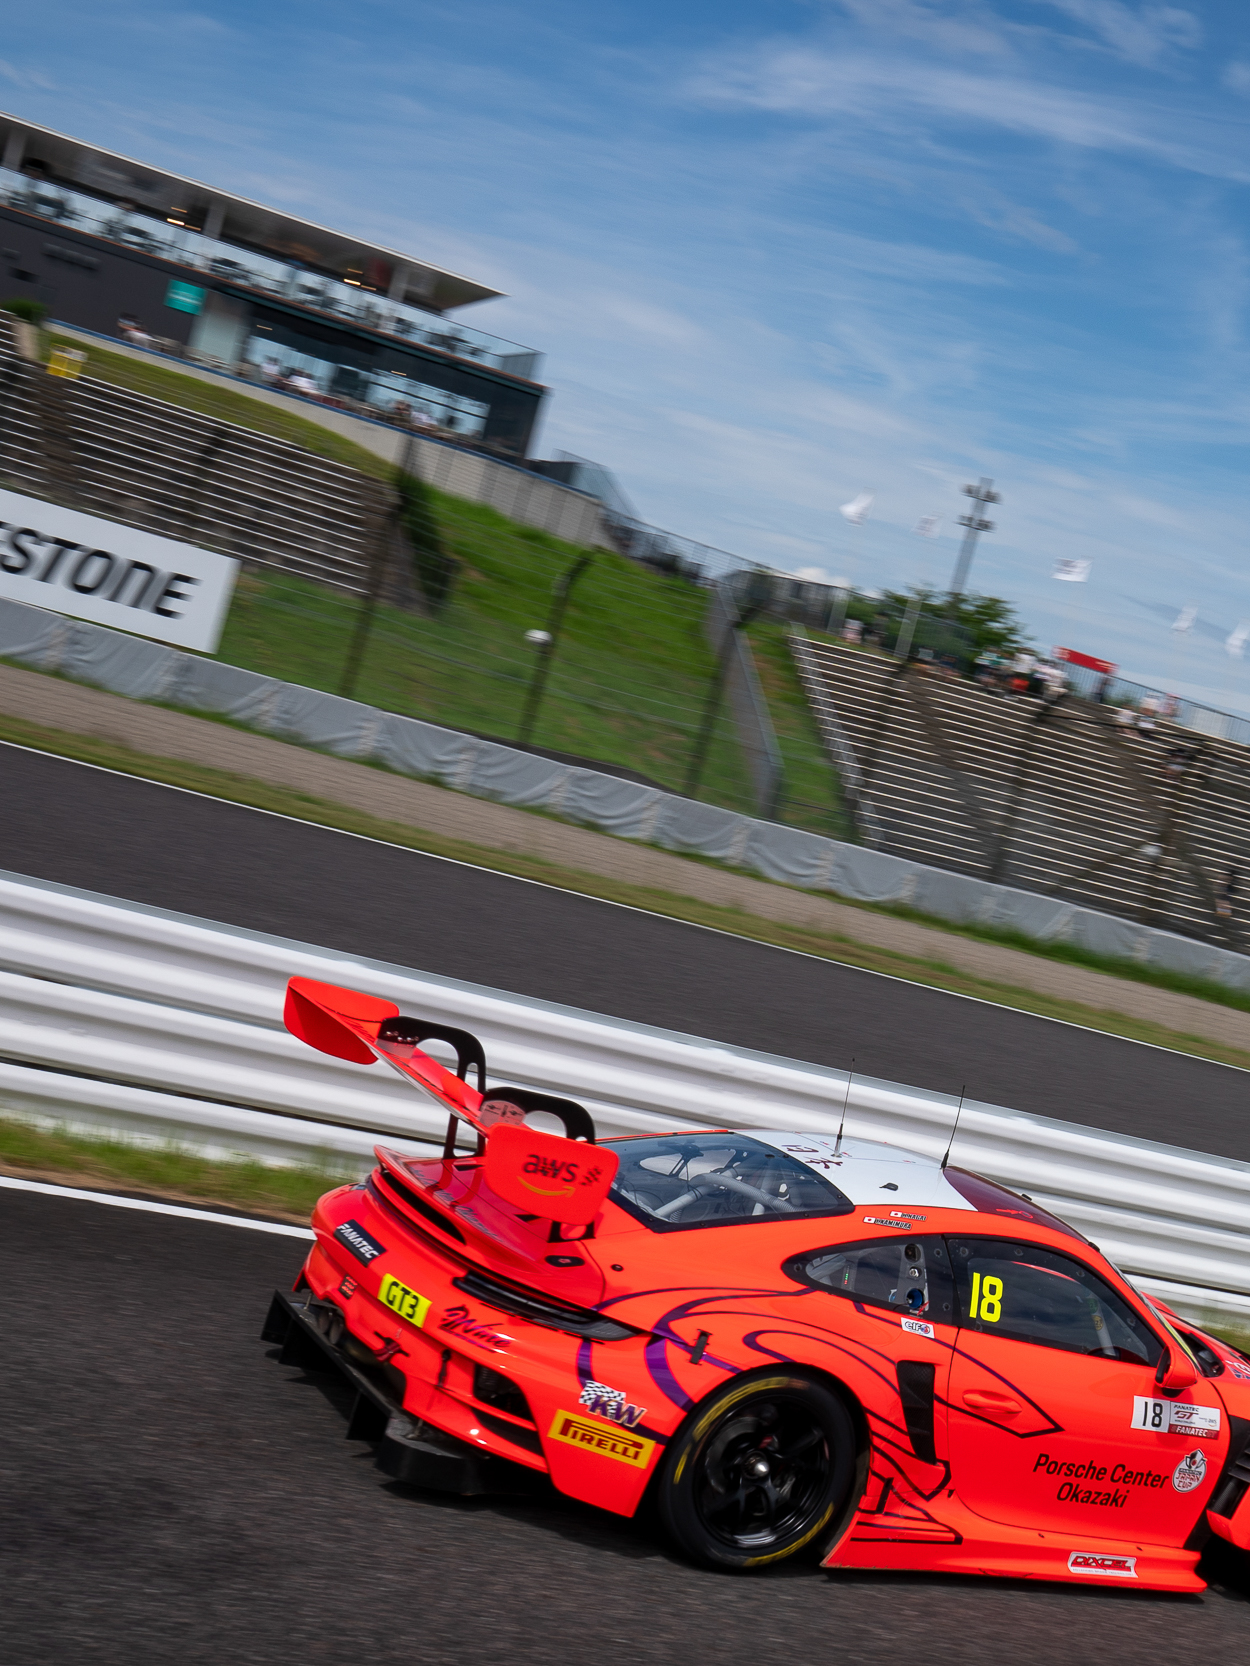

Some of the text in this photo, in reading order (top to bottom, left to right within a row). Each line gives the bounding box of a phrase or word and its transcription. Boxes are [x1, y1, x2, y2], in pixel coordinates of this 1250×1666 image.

[522, 1154, 578, 1183] aws
[337, 1223, 379, 1260] FANATEC
[386, 1280, 420, 1320] GT3
[969, 1271, 1004, 1323] 18
[587, 1393, 647, 1427] KW
[1141, 1400, 1164, 1429] 18
[1173, 1404, 1200, 1413] FANATEC
[559, 1418, 644, 1461] PIRELLI
[1033, 1453, 1169, 1489] Porsche Center
[1176, 1472, 1201, 1482] JAPAN
[1177, 1480, 1193, 1489] CUP
[1056, 1482, 1130, 1508] Okazaki
[1071, 1555, 1132, 1572] DIXCEL
